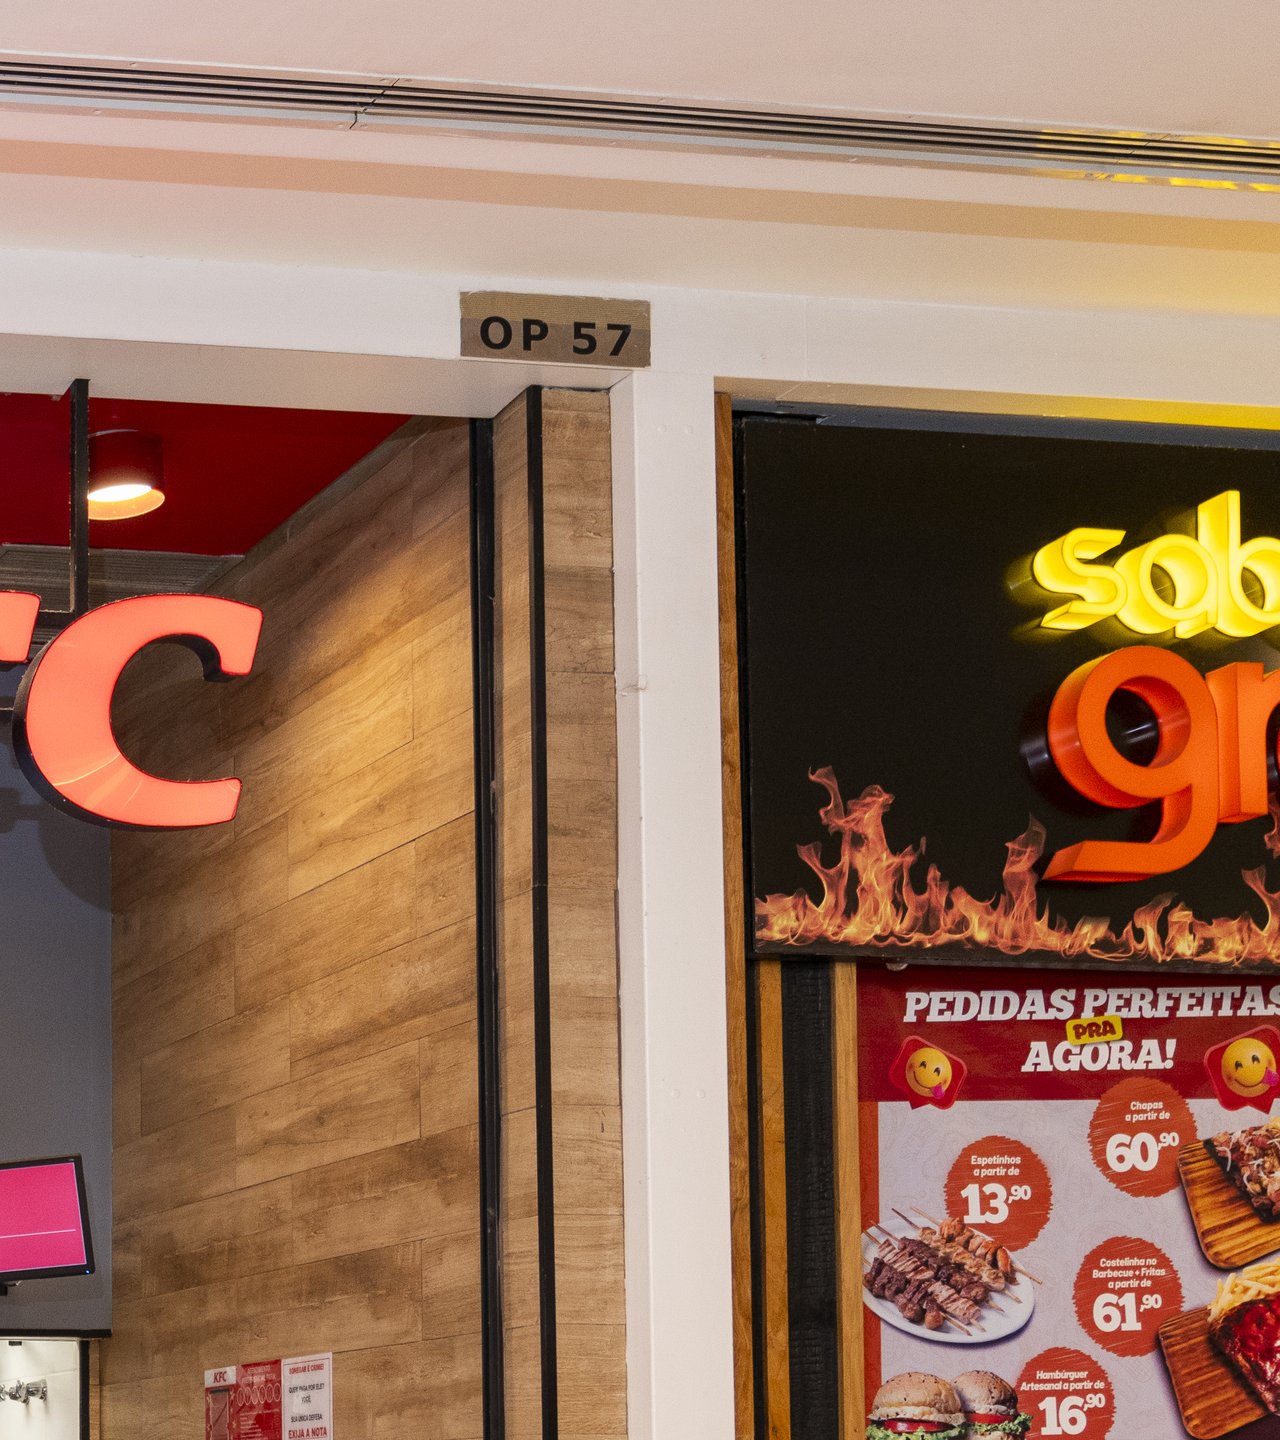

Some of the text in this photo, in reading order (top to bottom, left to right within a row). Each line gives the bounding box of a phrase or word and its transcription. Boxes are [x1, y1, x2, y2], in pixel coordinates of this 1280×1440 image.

[478, 314, 633, 358] OP 57
[904, 985, 1280, 1023] PEDIDAS PERFEITAS
[1072, 1021, 1116, 1040] PRA
[1021, 1037, 1177, 1073] AGORA!
[1131, 1101, 1163, 1112] Chapas
[1106, 1132, 1179, 1173] 60,90
[971, 1155, 1021, 1167] Espetinhos
[961, 1183, 1031, 1224] 13,90
[1100, 1258, 1145, 1267] Costelinha
[1093, 1268, 1165, 1279] Barbecue Fritas
[1093, 1293, 1162, 1333] 61,90
[214, 1371, 227, 1383] KFC
[1036, 1370, 1088, 1381] Hambúrguer
[1020, 1381, 1061, 1391] Artesanal
[1039, 1394, 1105, 1435] 16,90
[288, 1427, 327, 1439] EXIJA A NOTA
